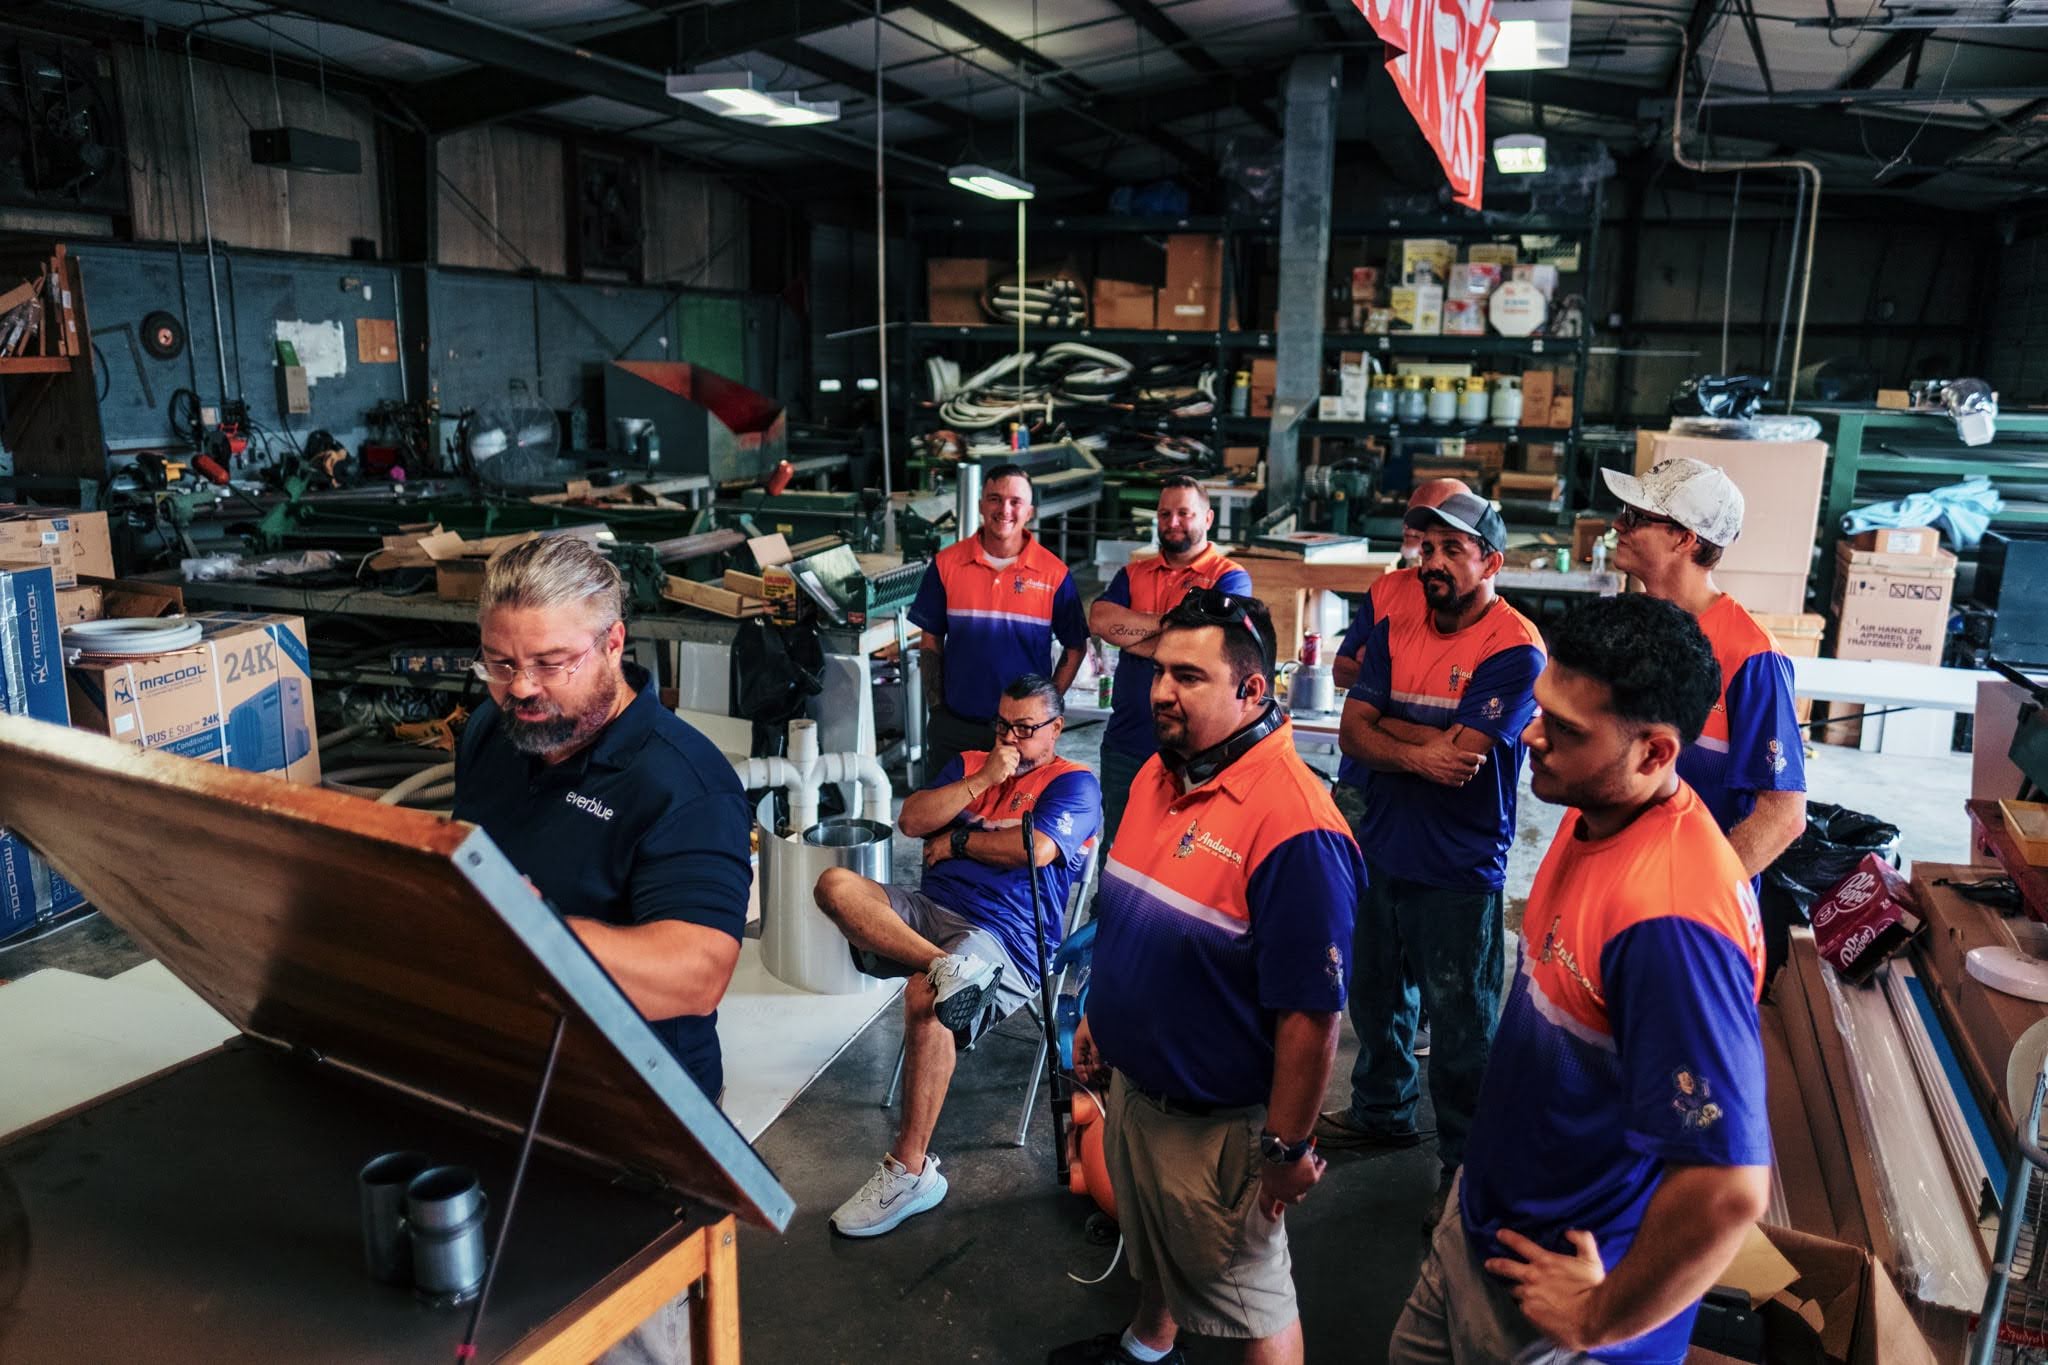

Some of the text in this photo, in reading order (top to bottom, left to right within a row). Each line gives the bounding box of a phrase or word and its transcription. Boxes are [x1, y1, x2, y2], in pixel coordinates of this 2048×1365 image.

[27, 584, 41, 659] MRCOOL
[1860, 624, 1922, 635] AIR HANDLER
[1848, 638, 1904, 649] TRAITEMENT
[1860, 632, 1920, 643] APPAREIL DE
[224, 642, 276, 684] 24K
[140, 665, 207, 691] MRCOOL
[202, 712, 220, 726] 24K
[176, 733, 214, 751] Conditioner
[565, 791, 614, 820] everblue
[1197, 832, 1242, 864] Anderson
[4, 847, 20, 920] MRCOOL
[1845, 932, 1859, 951] Dr
